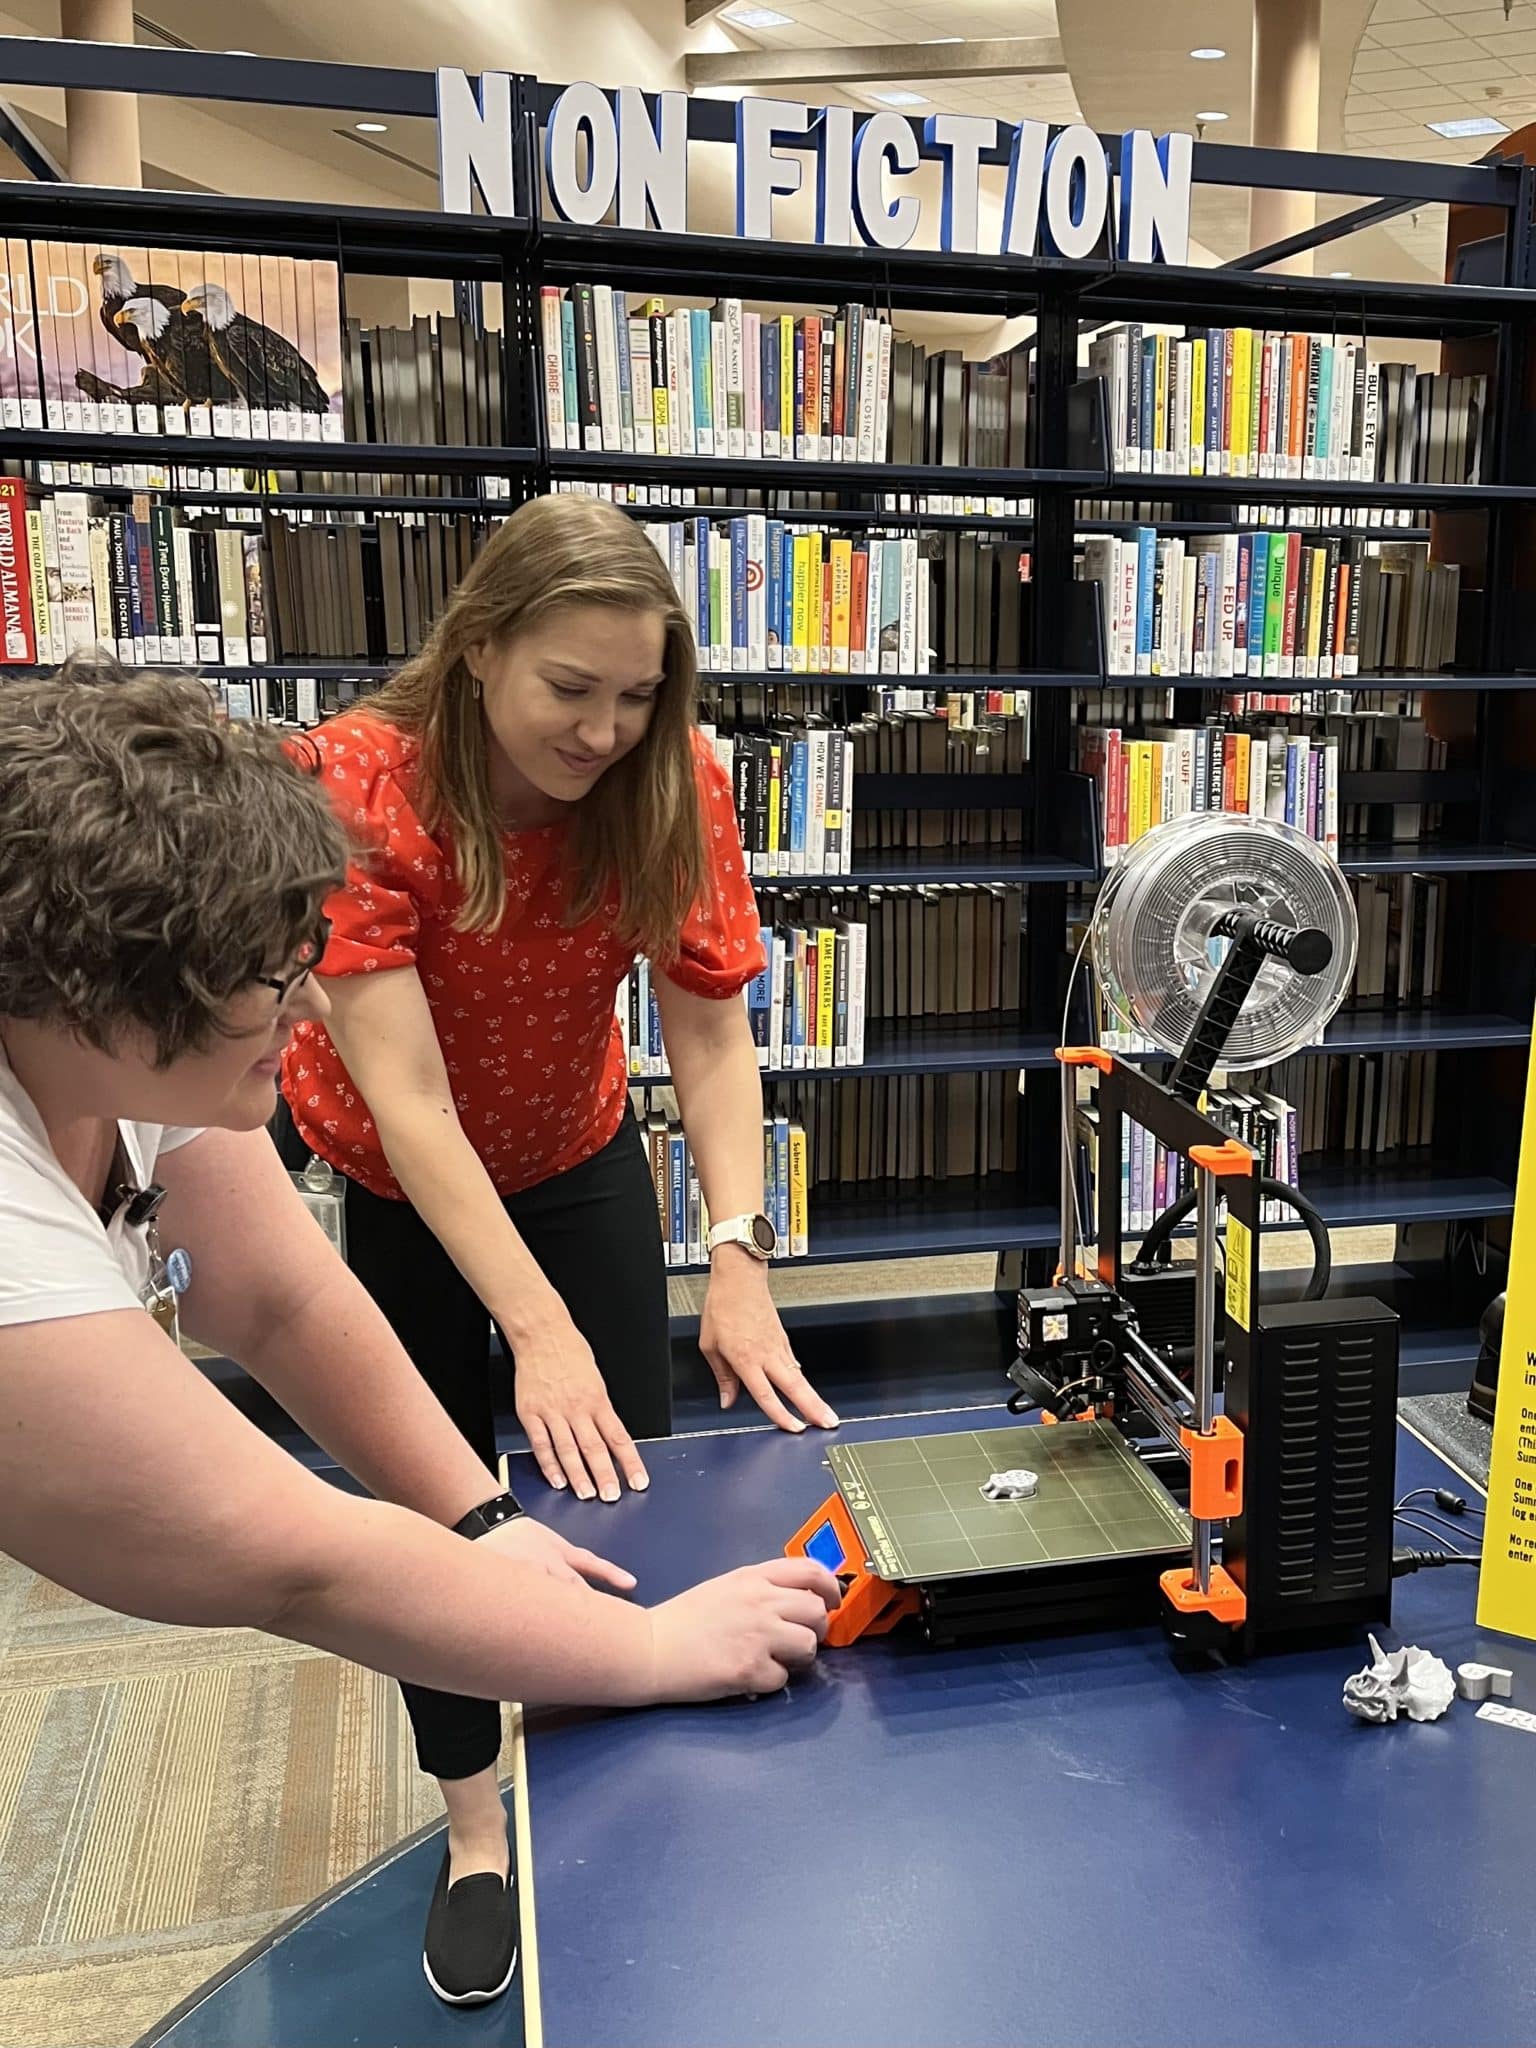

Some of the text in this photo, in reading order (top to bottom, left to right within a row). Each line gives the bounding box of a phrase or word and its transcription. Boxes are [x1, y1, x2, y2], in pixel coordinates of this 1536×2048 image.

[437, 66, 1193, 266] NON FICTION
[728, 305, 740, 345] ESCAPE
[655, 318, 665, 386] Anger Management
[882, 333, 890, 347] FEAR
[547, 354, 559, 393] CHARGE
[807, 327, 815, 416] HEAR YOURSELF
[1310, 342, 1320, 384] SPARTAN
[823, 386, 830, 394] OF
[865, 365, 873, 389] WIN
[1309, 388, 1319, 404] UP!
[822, 396, 830, 424] CLOSURE
[1365, 375, 1377, 449] BULL'S EYE
[0, 511, 16, 567] WORLD
[113, 519, 121, 539] PAUL
[736, 529, 744, 545] Blue
[116, 542, 124, 583] JOHNSON
[736, 547, 744, 573] Zones
[772, 527, 782, 579] Happiness
[130, 565, 138, 586] BEING
[1272, 557, 1285, 597] Unique
[797, 561, 807, 631] happier now
[904, 592, 912, 621] Miracle
[1288, 588, 1296, 605] The
[1352, 581, 1360, 606] VOICES
[1222, 586, 1234, 640] FED UP.
[1286, 607, 1296, 634] Power
[903, 630, 911, 650] Love
[1326, 625, 1334, 639] Girl
[815, 741, 825, 819] HOW WE CHANGE
[1181, 750, 1190, 785] STUFF
[1211, 741, 1222, 794] RESILIENCE
[824, 937, 832, 960] GAME
[756, 975, 765, 1001] MORE
[823, 964, 832, 1008] CHANGERS
[690, 1178, 699, 1201] DANCE
[1515, 1478, 1532, 1491] One
[1512, 1506, 1526, 1520] log
[1510, 1533, 1521, 1545] No
[1508, 1550, 1533, 1563] enter
[1480, 1706, 1536, 1731] PR
